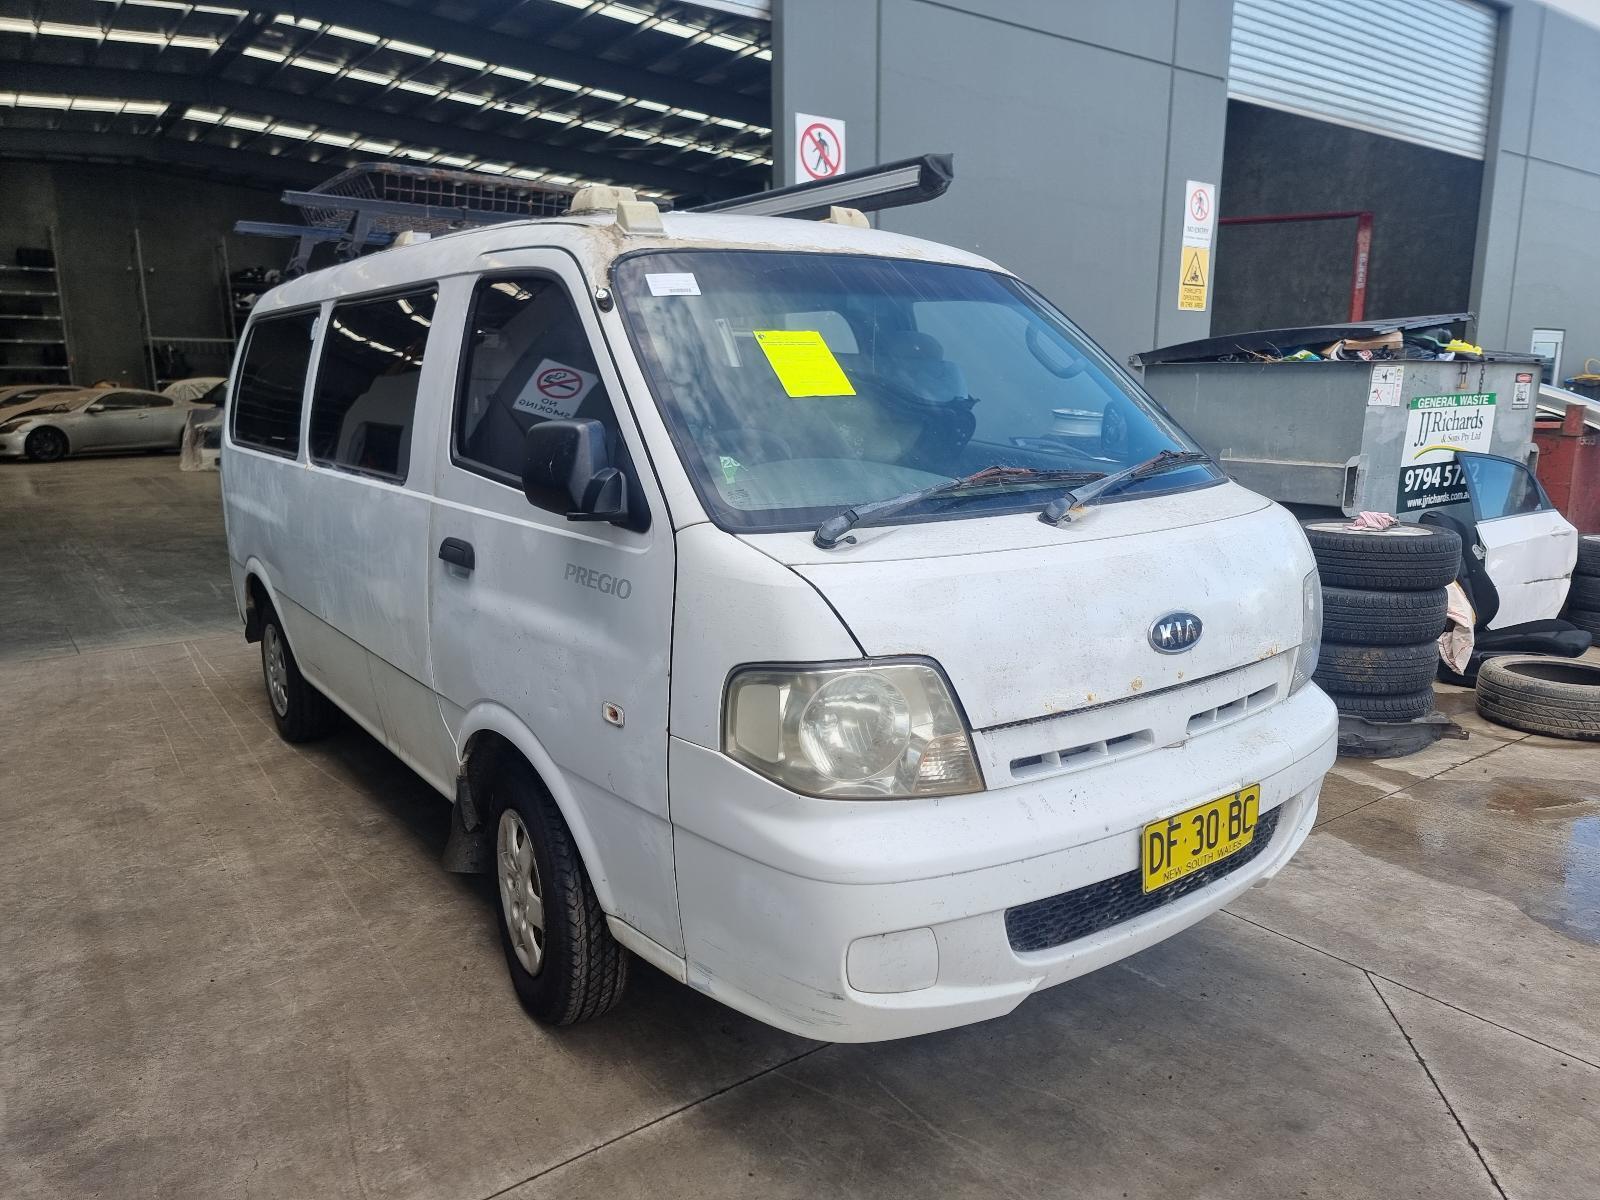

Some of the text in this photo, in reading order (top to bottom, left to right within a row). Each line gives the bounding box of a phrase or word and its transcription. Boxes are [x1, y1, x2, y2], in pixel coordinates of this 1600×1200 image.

[1417, 394, 1490, 409] GENERAL WASTE
[1447, 432, 1460, 443] Sons
[1461, 432, 1470, 444] Pty
[1471, 431, 1481, 441] Ltd
[1404, 466, 1441, 493] 9794
[564, 562, 632, 600] PREGIO
[1159, 619, 1198, 647] KIA
[1149, 794, 1255, 875] DF 30 BC
[1163, 840, 1242, 882] NEW SOUTH WALES
